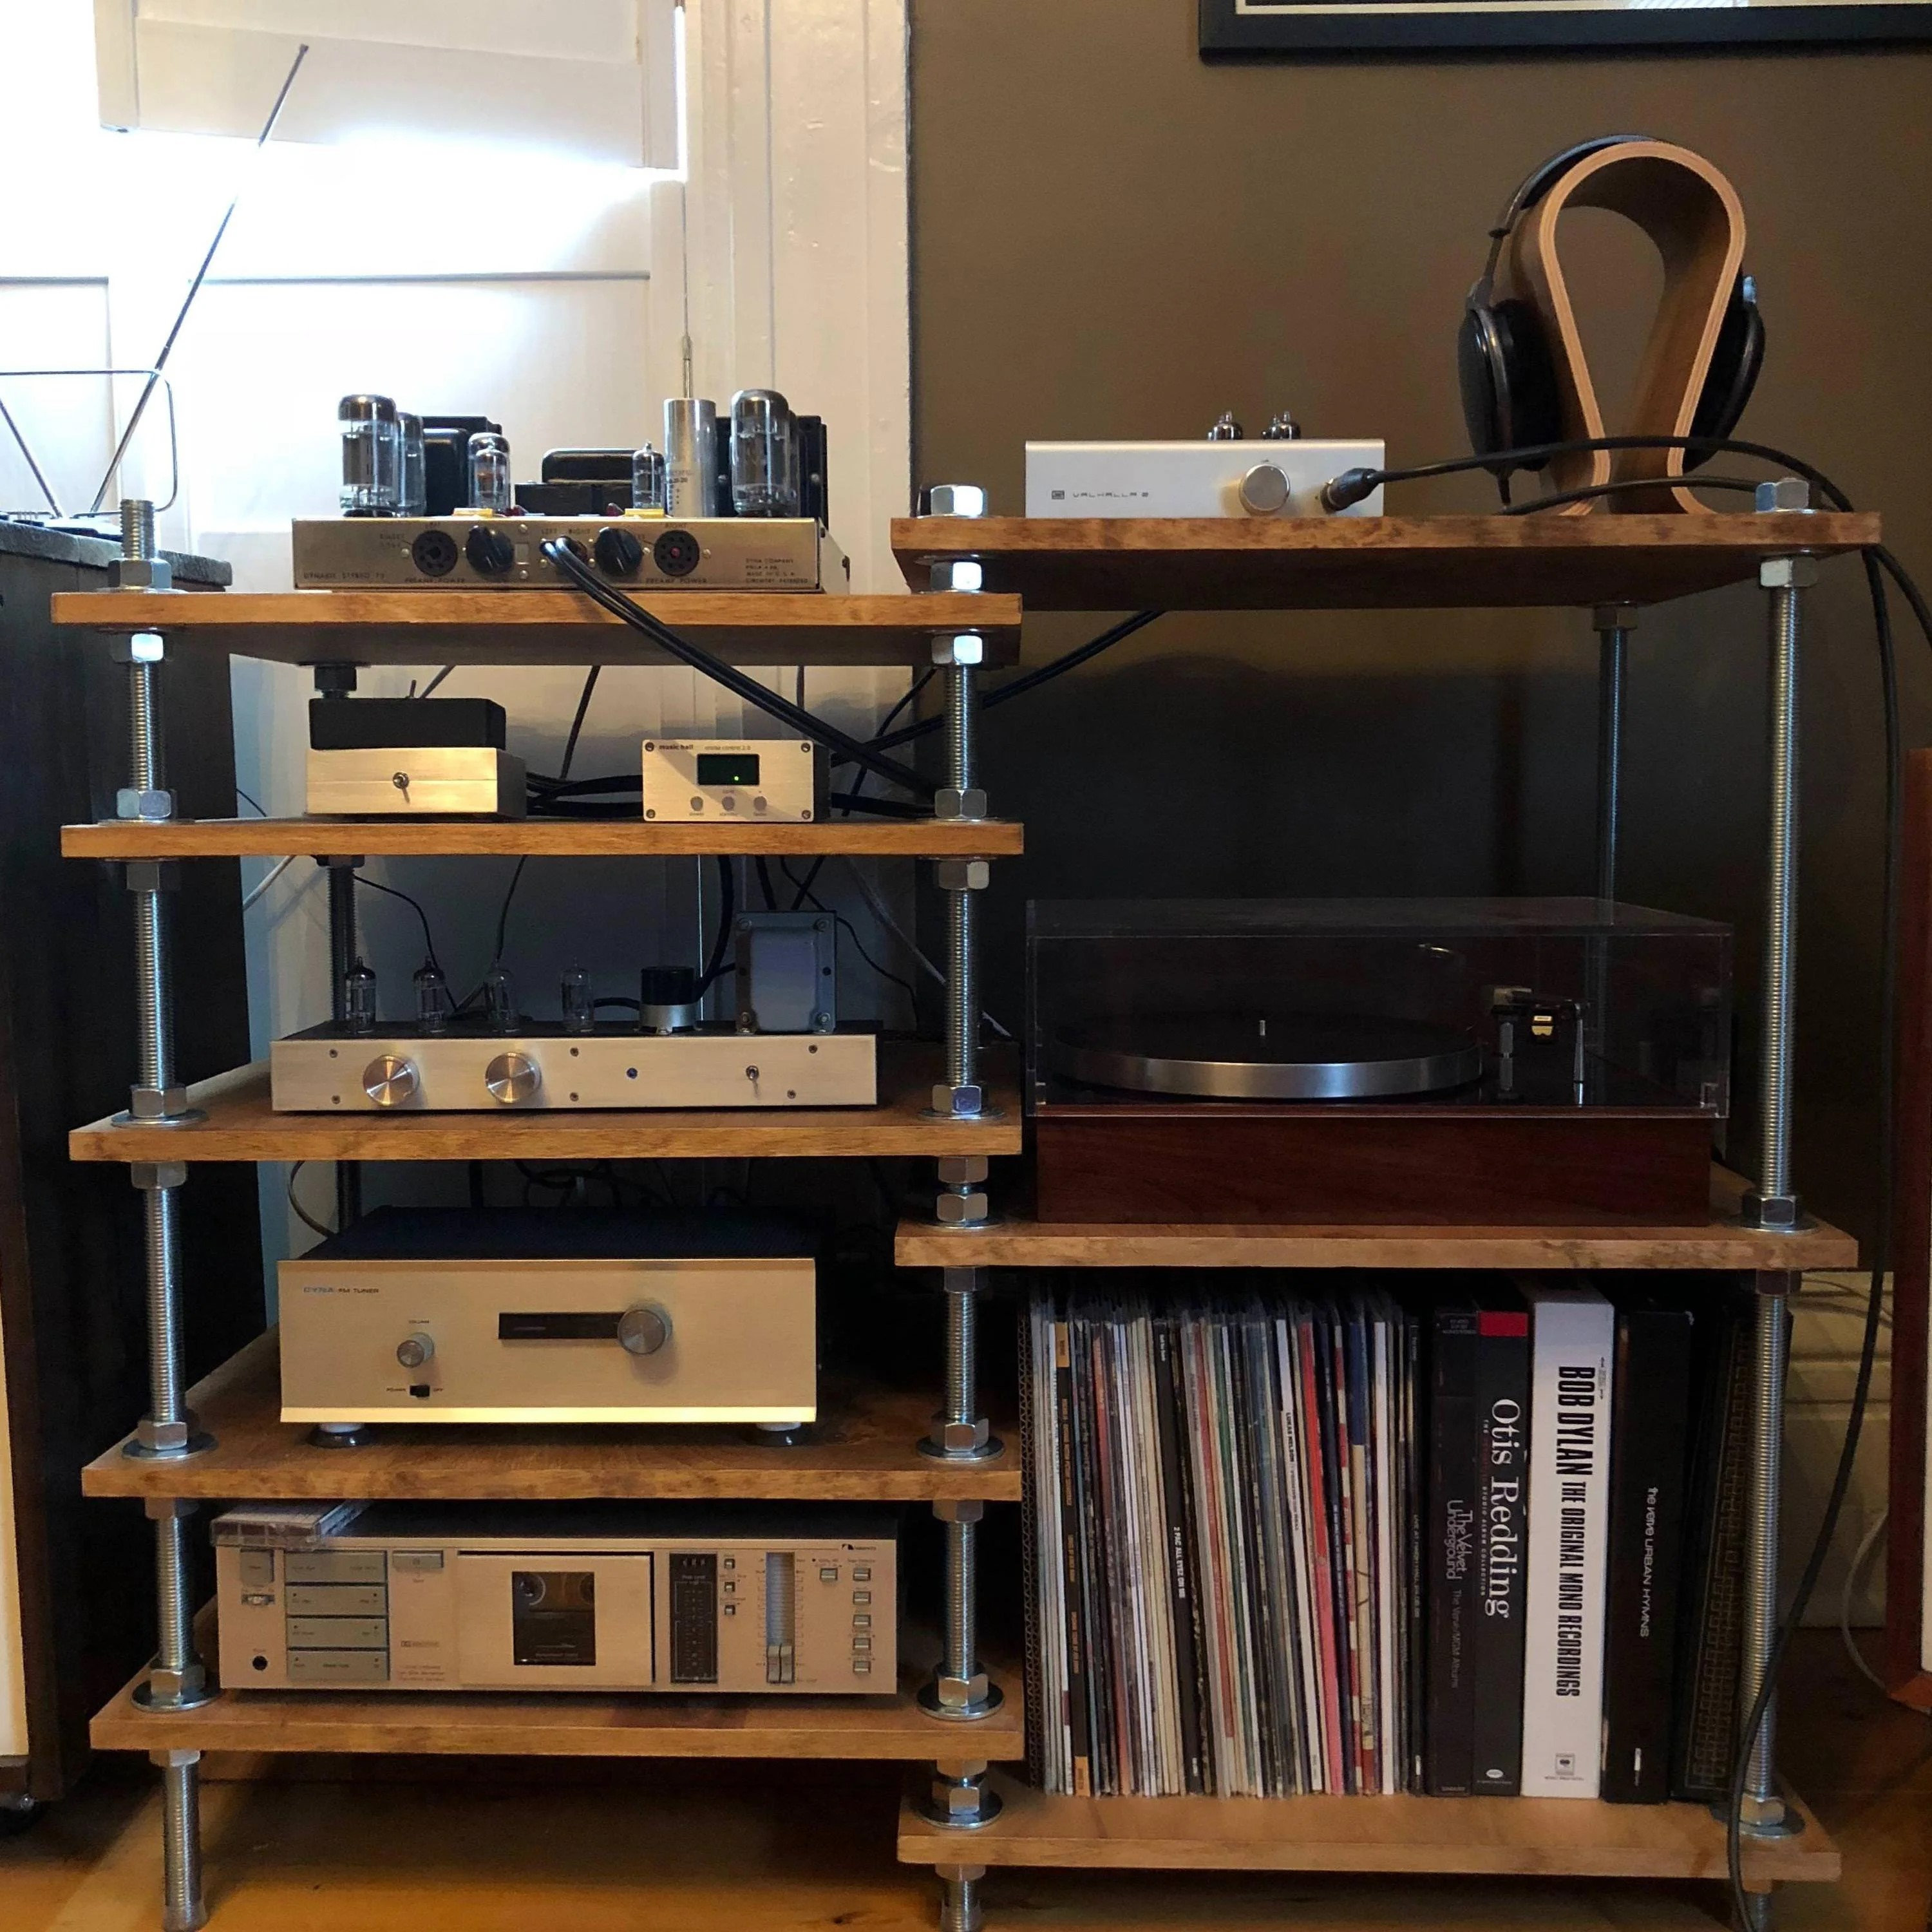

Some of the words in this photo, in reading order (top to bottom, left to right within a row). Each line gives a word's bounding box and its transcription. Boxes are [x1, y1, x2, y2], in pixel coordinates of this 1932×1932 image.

[1558, 1366, 1595, 1406] BOB
[1492, 1399, 1520, 1464] Otis
[1555, 1412, 1594, 1475] DYLAN
[1561, 1482, 1586, 1503] THE
[1444, 1500, 1464, 1580] Underground
[1455, 1510, 1473, 1535] The
[1484, 1475, 1519, 1618] Redding
[1560, 1508, 1586, 1568] ORIGINAL
[1455, 1533, 1473, 1571] Velvet
[1643, 1538, 1654, 1585] URBAN
[1558, 1573, 1584, 1610] MONO
[1640, 1588, 1651, 1638] HYMNS
[1555, 1615, 1582, 1697] RECORDINGS
